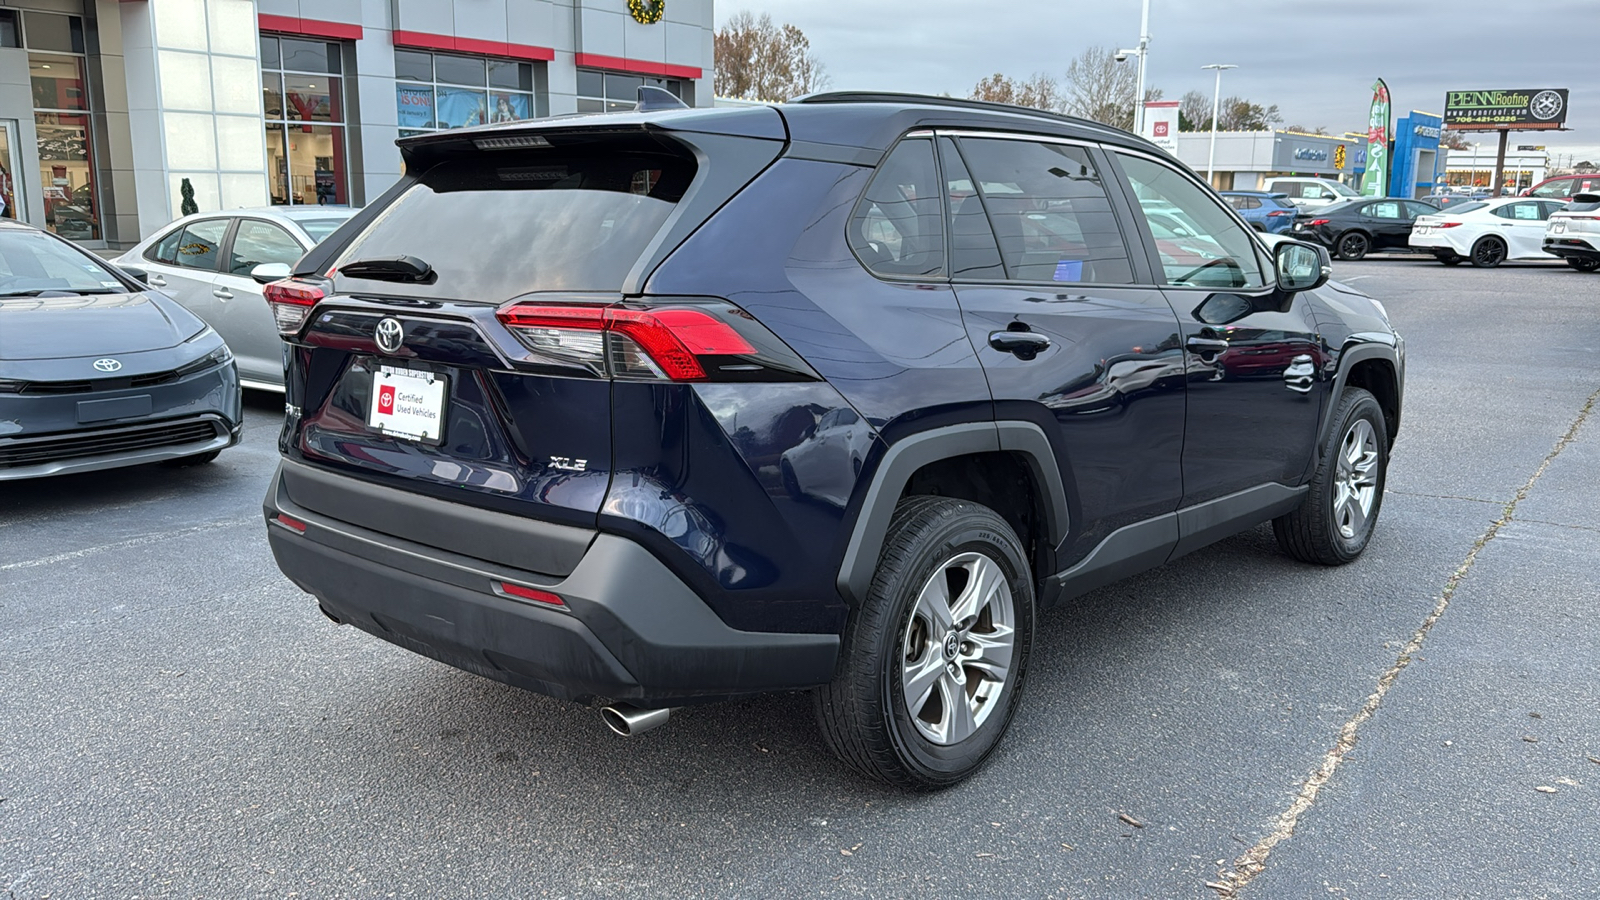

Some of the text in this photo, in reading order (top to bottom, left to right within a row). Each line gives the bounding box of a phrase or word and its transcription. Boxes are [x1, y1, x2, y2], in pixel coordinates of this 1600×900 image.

[401, 95, 411, 106] IS
[1448, 91, 1497, 106] PENN
[1495, 92, 1529, 108] Roofing
[1446, 108, 1528, 117] www.pennroof.com
[397, 391, 424, 405] Certified
[396, 404, 437, 420] Used Vehicles
[547, 455, 588, 472] XLE
